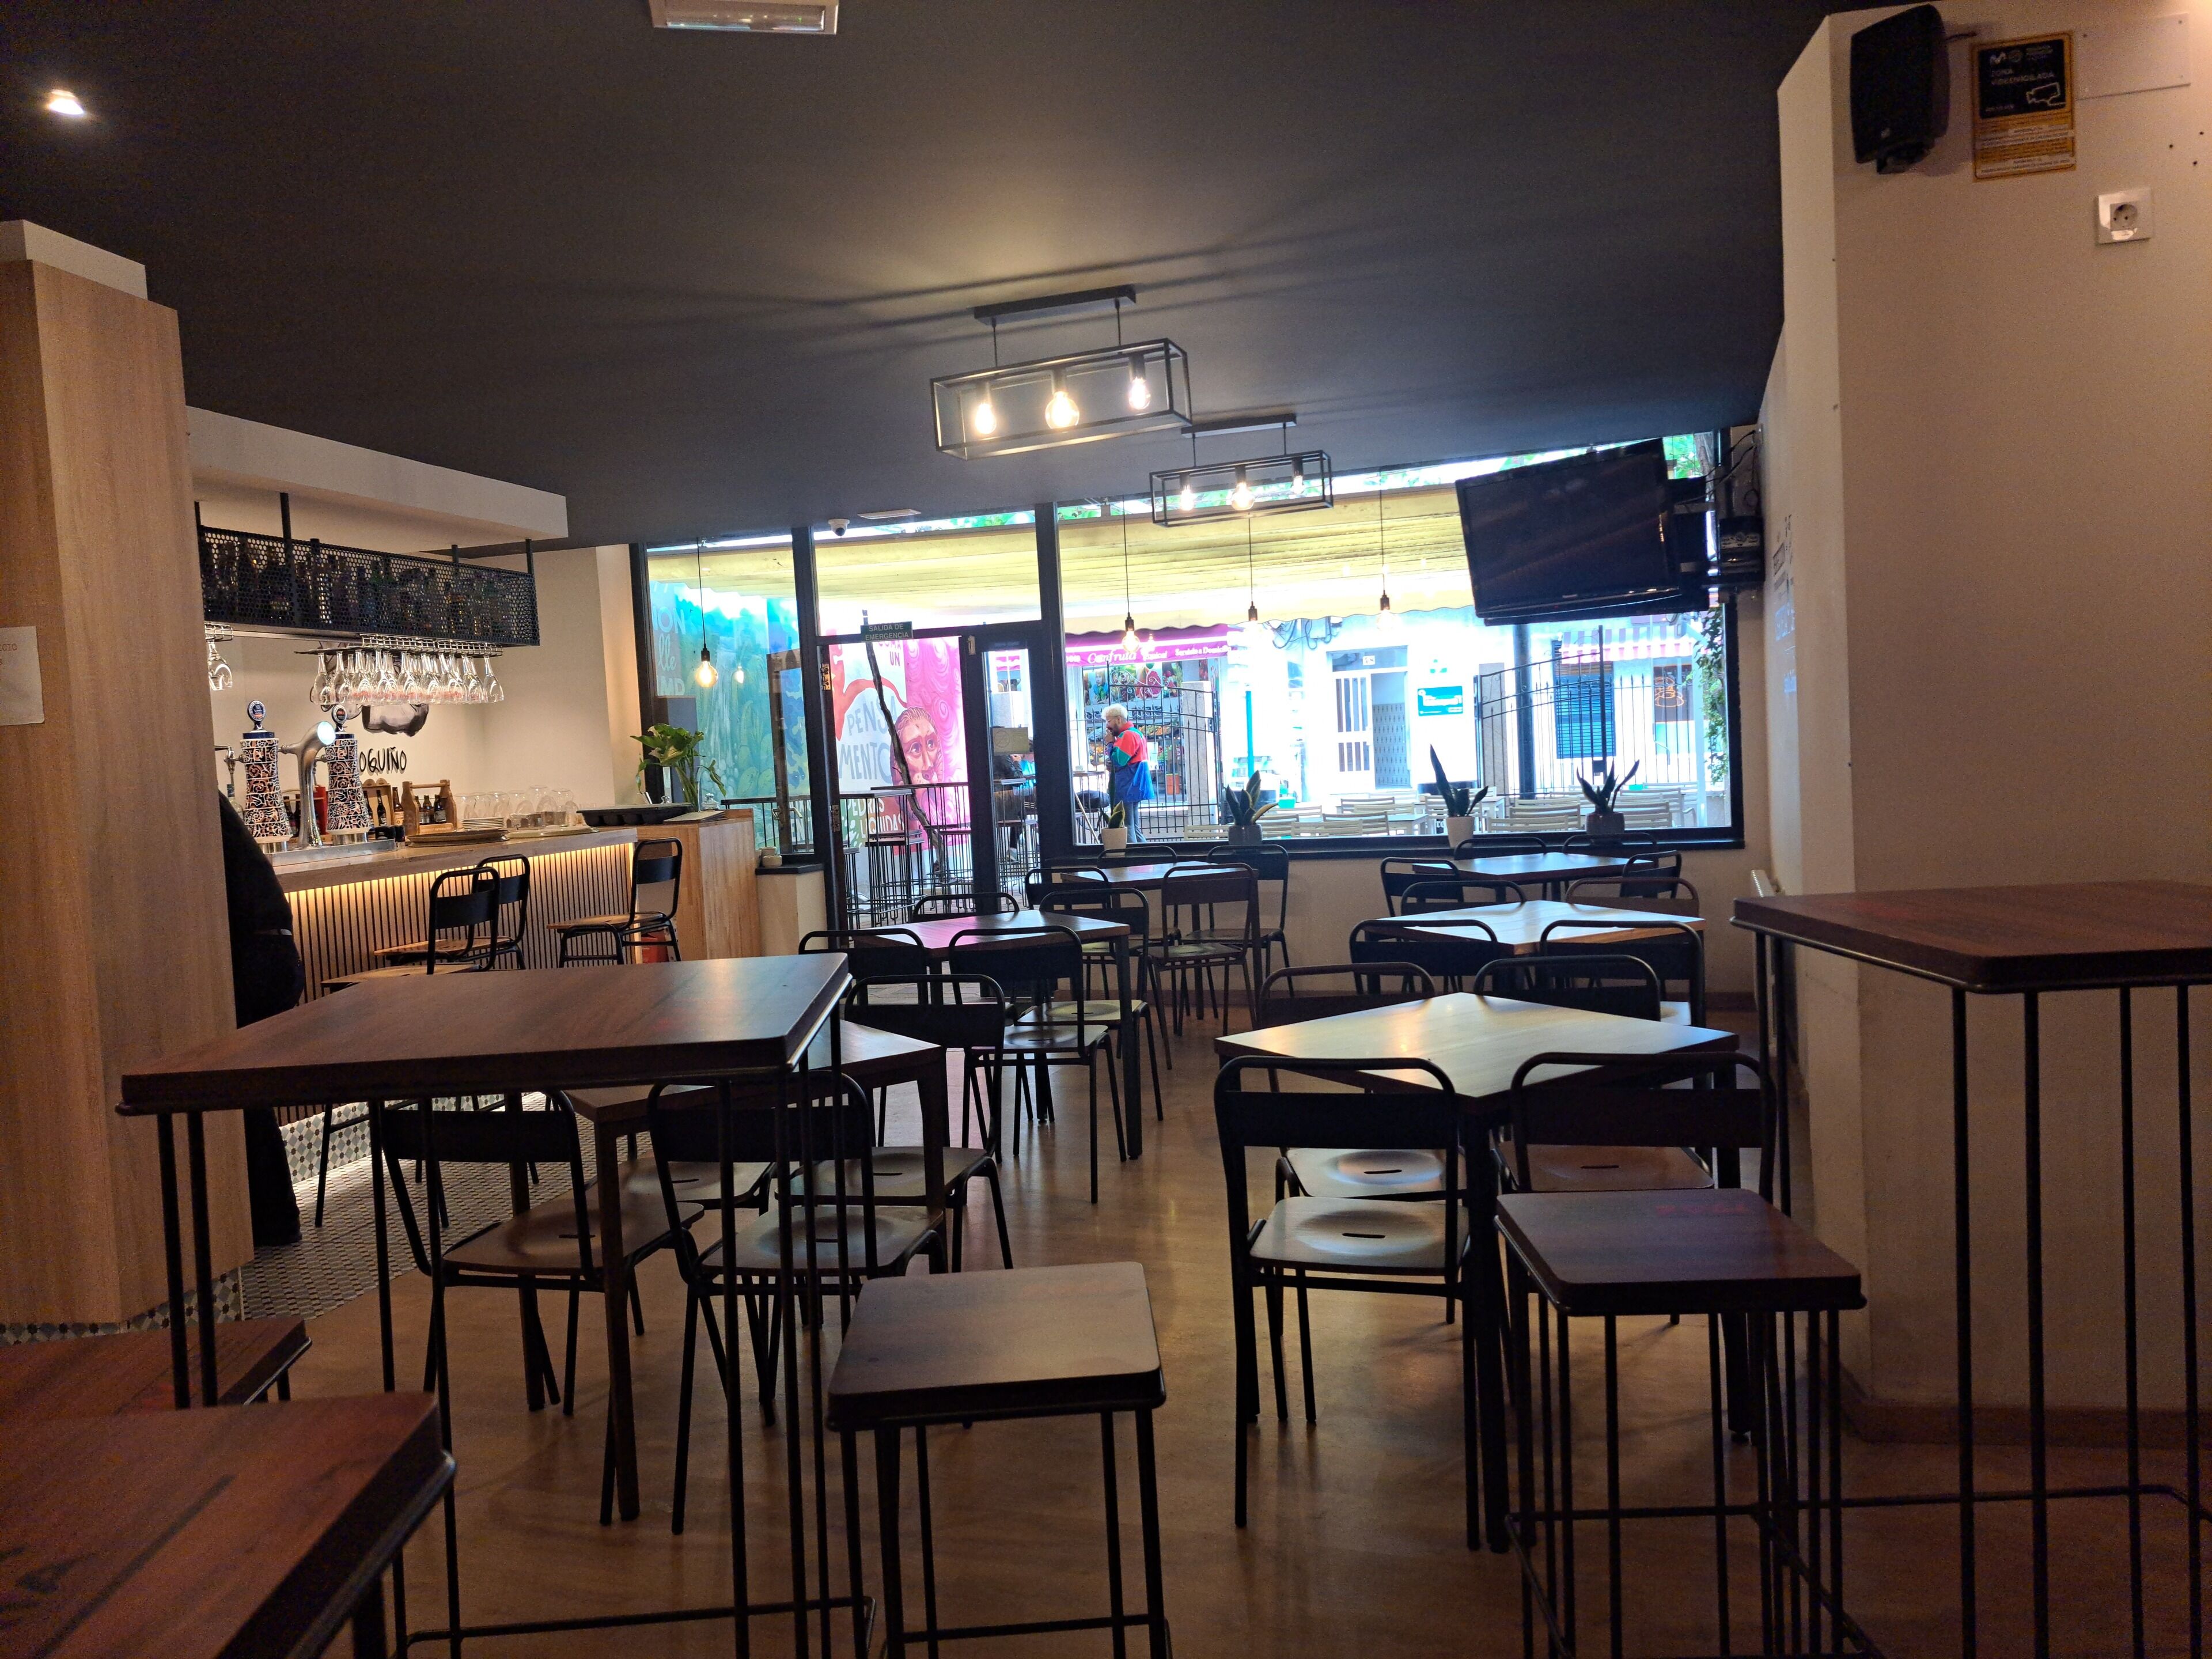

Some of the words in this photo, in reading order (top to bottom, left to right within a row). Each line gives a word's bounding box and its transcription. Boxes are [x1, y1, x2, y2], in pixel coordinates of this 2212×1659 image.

[865, 632, 909, 641] EMERGENCIA
[889, 651, 900, 666] UN
[359, 747, 407, 772] OQUIÑO
